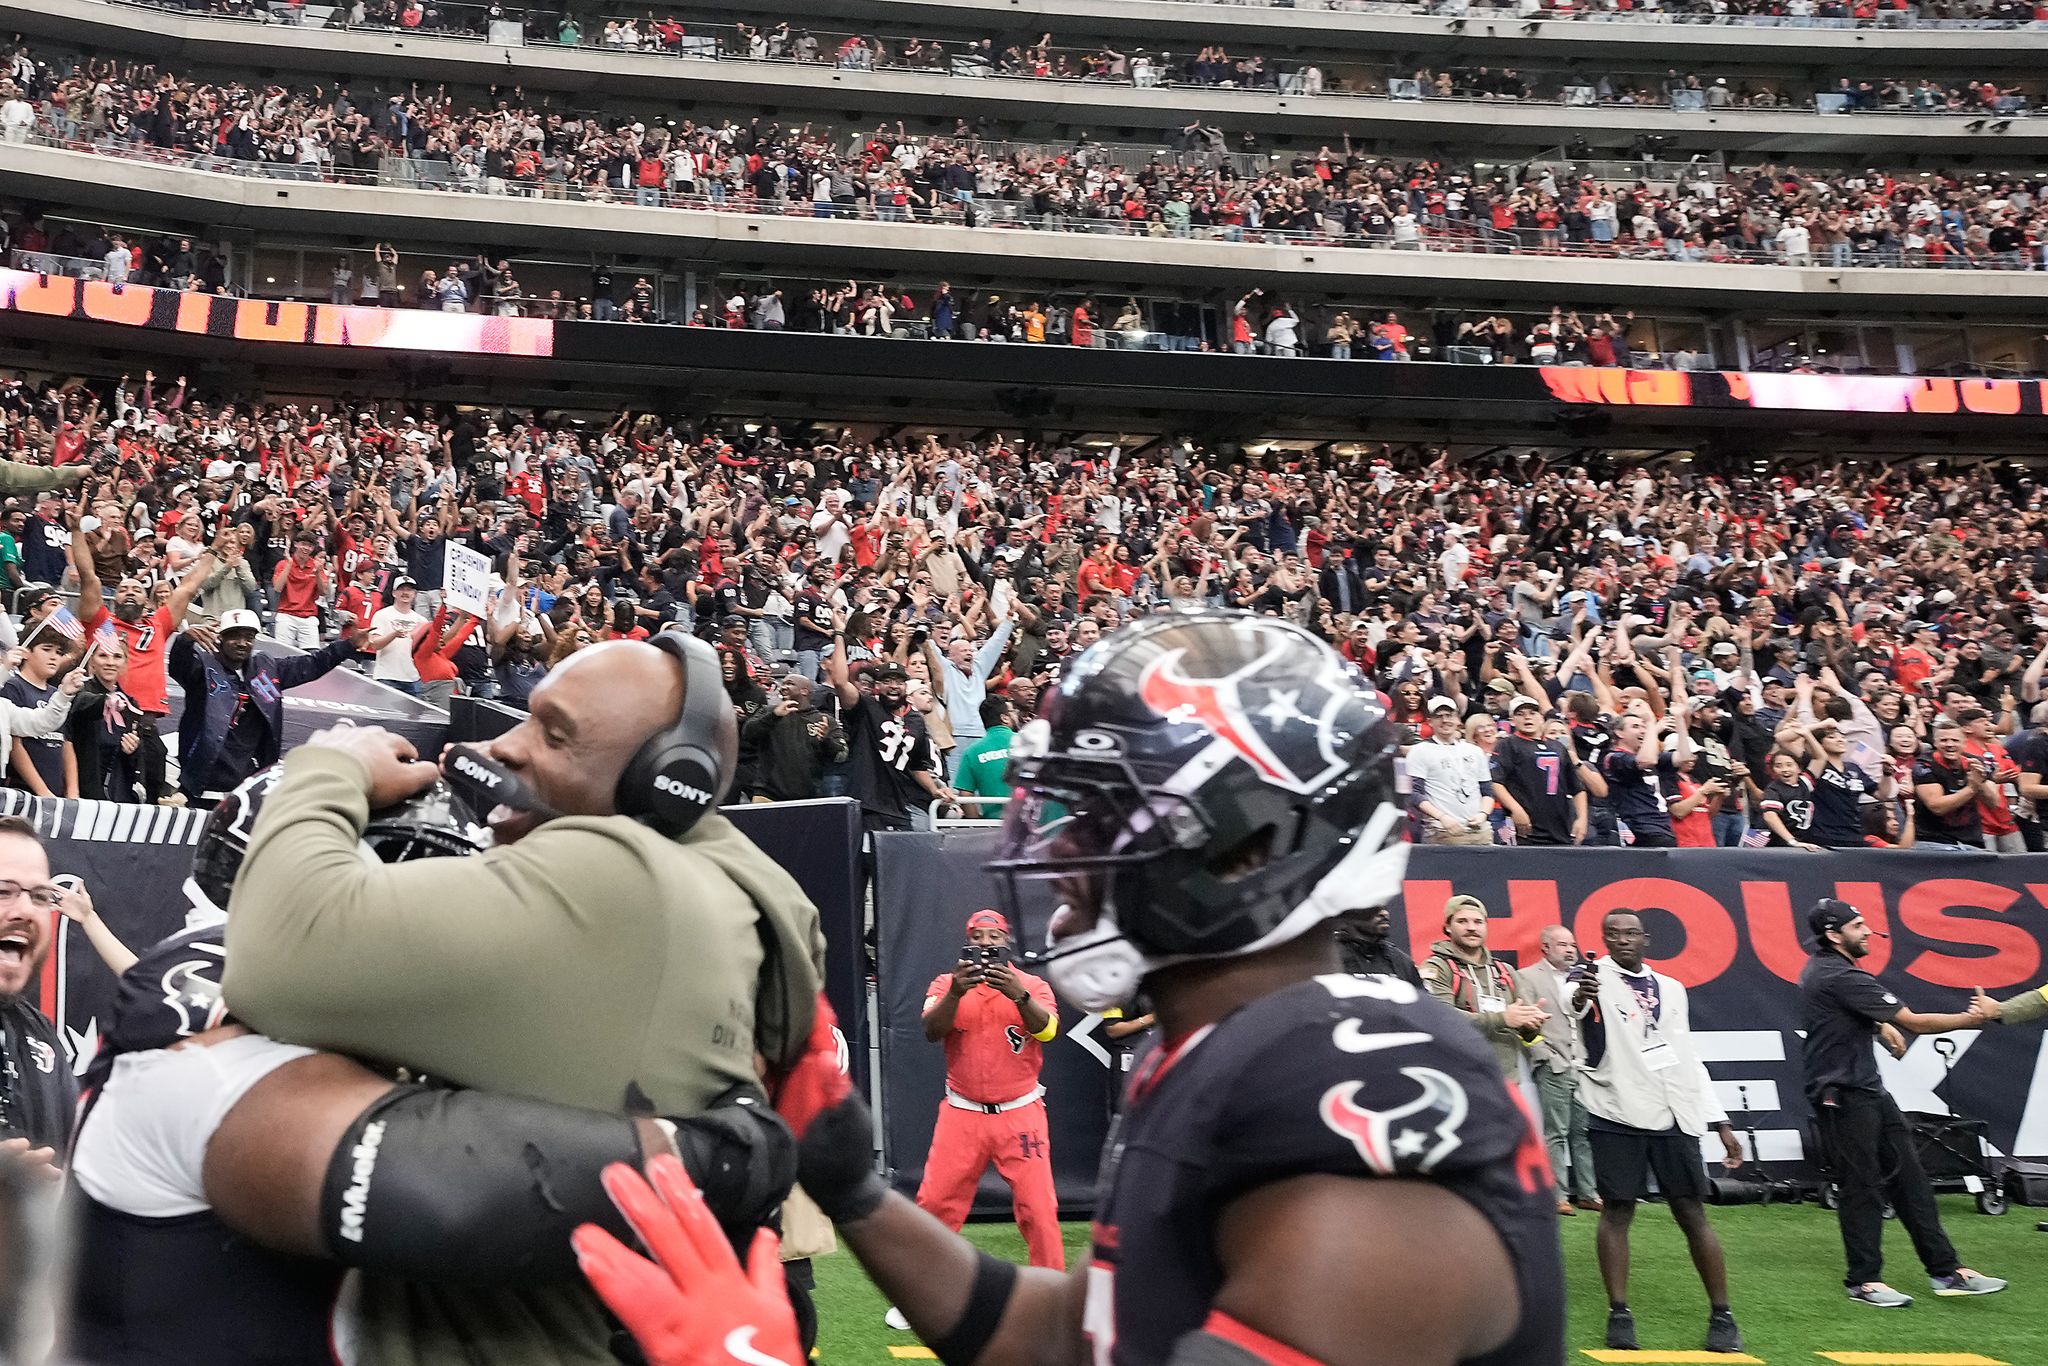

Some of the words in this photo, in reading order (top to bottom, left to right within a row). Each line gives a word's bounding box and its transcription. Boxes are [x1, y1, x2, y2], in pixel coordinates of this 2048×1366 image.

[362, 600, 373, 620] 7
[879, 720, 916, 772] 31
[453, 755, 503, 788] SONY
[653, 774, 713, 805] SONY
[1535, 756, 1561, 795] 7
[1402, 877, 2048, 988] HOUS
[340, 1121, 386, 1228] Mueller
